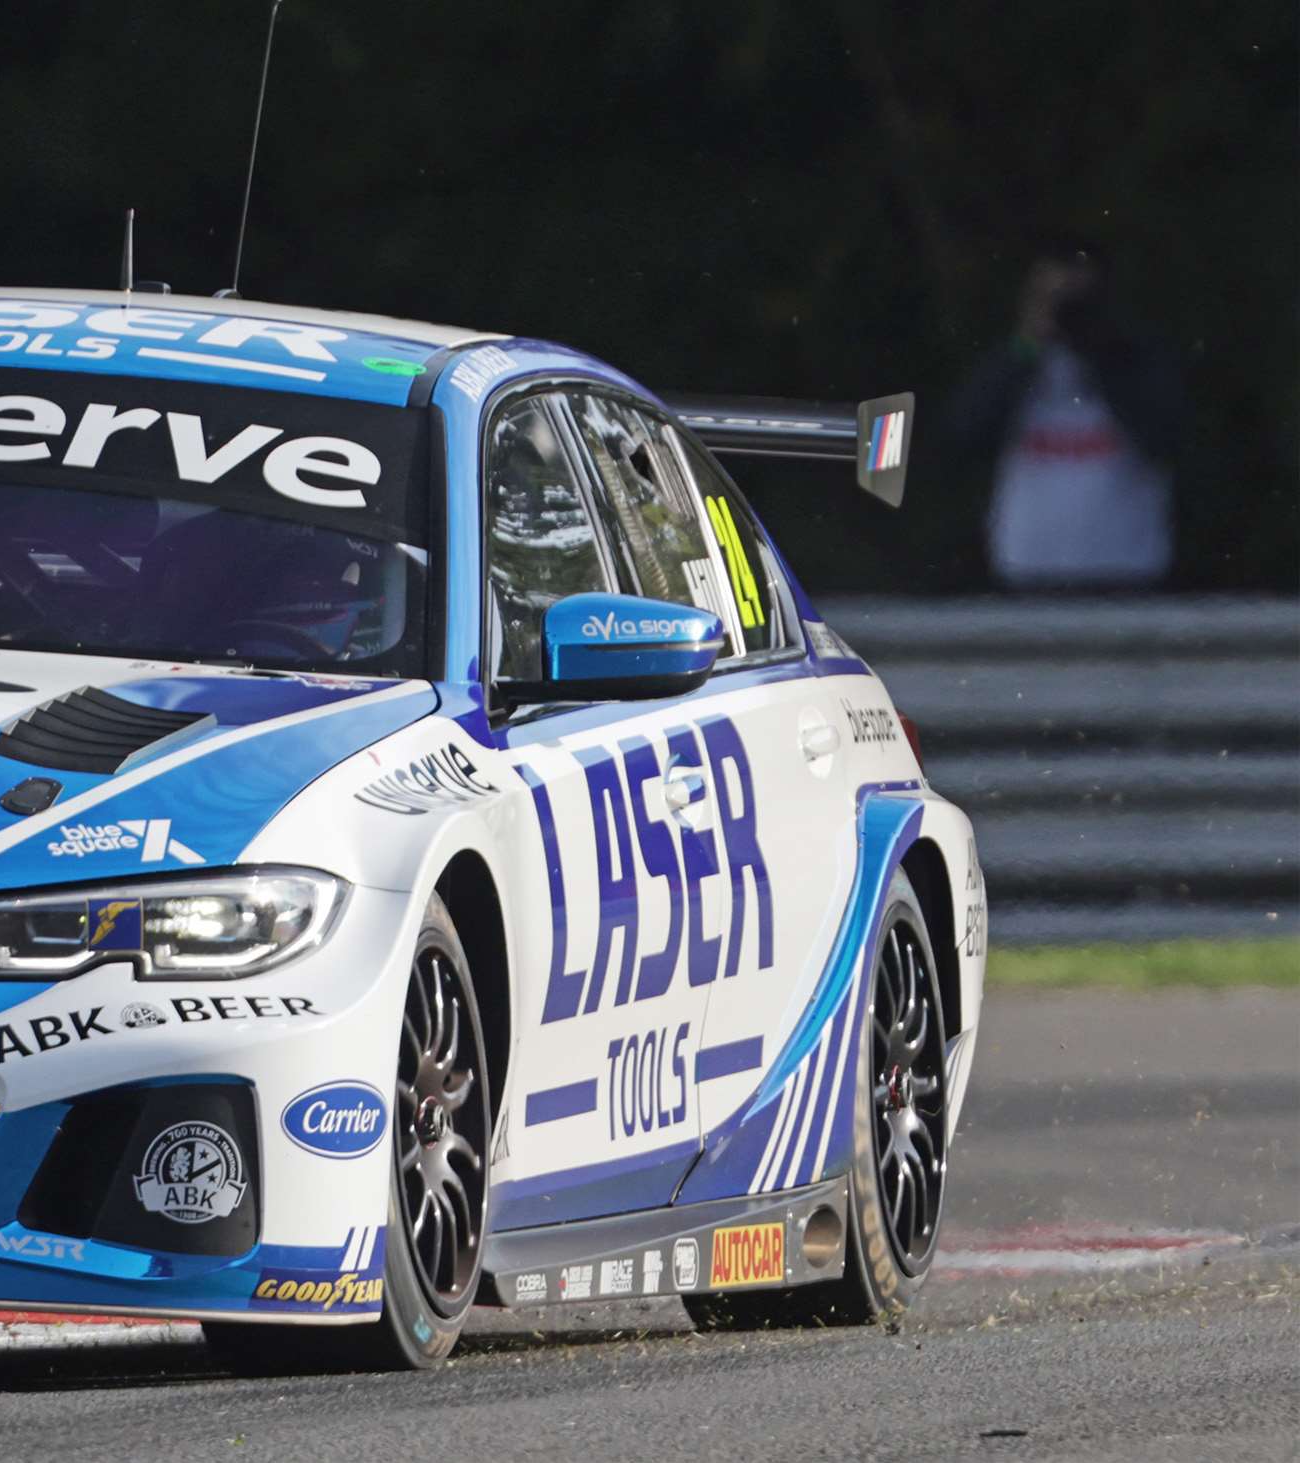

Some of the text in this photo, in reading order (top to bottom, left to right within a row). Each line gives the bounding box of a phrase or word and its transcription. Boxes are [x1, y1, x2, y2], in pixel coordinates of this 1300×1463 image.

[47, 834, 139, 858] square
[60, 822, 123, 842] blue
[511, 712, 775, 1026] LASER
[170, 996, 326, 1026] BEER
[606, 1022, 692, 1142] TOOLS
[302, 1100, 381, 1135] Carrier
[189, 1126, 220, 1142] YEARS
[164, 1186, 217, 1210] ABK
[712, 1228, 782, 1284] AUTOCAR
[256, 1277, 384, 1305] GOODYEAR
[515, 1272, 548, 1292] COBRA
